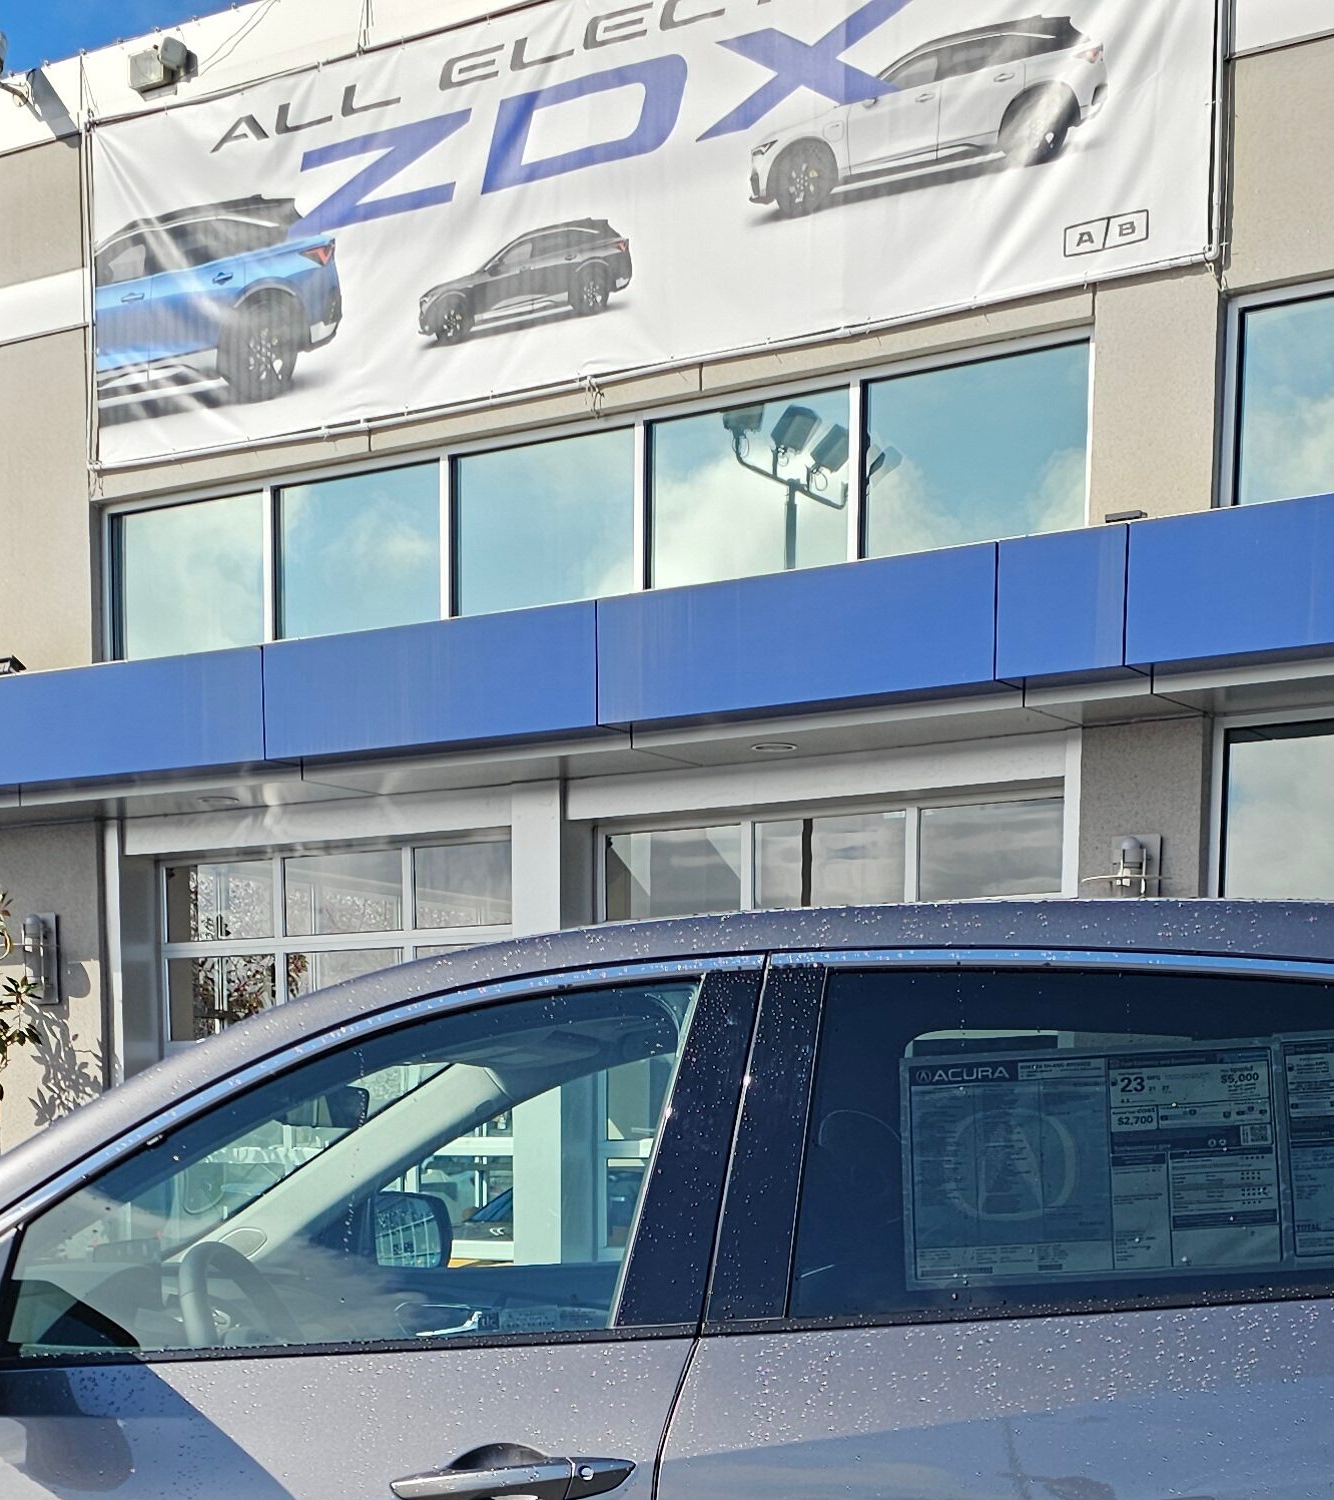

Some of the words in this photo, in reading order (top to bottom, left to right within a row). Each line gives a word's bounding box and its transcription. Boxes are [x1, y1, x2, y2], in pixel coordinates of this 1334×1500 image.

[210, 84, 402, 154] ALL
[438, 0, 771, 92] ELEC
[287, 0, 911, 240] ZDX
[1075, 230, 1095, 247] A
[1117, 221, 1136, 237] B
[931, 1066, 1011, 1083] ACURA
[1220, 1072, 1260, 1085] $5,000
[1120, 1076, 1146, 1094] 23
[1117, 1115, 1154, 1126] $2,700
